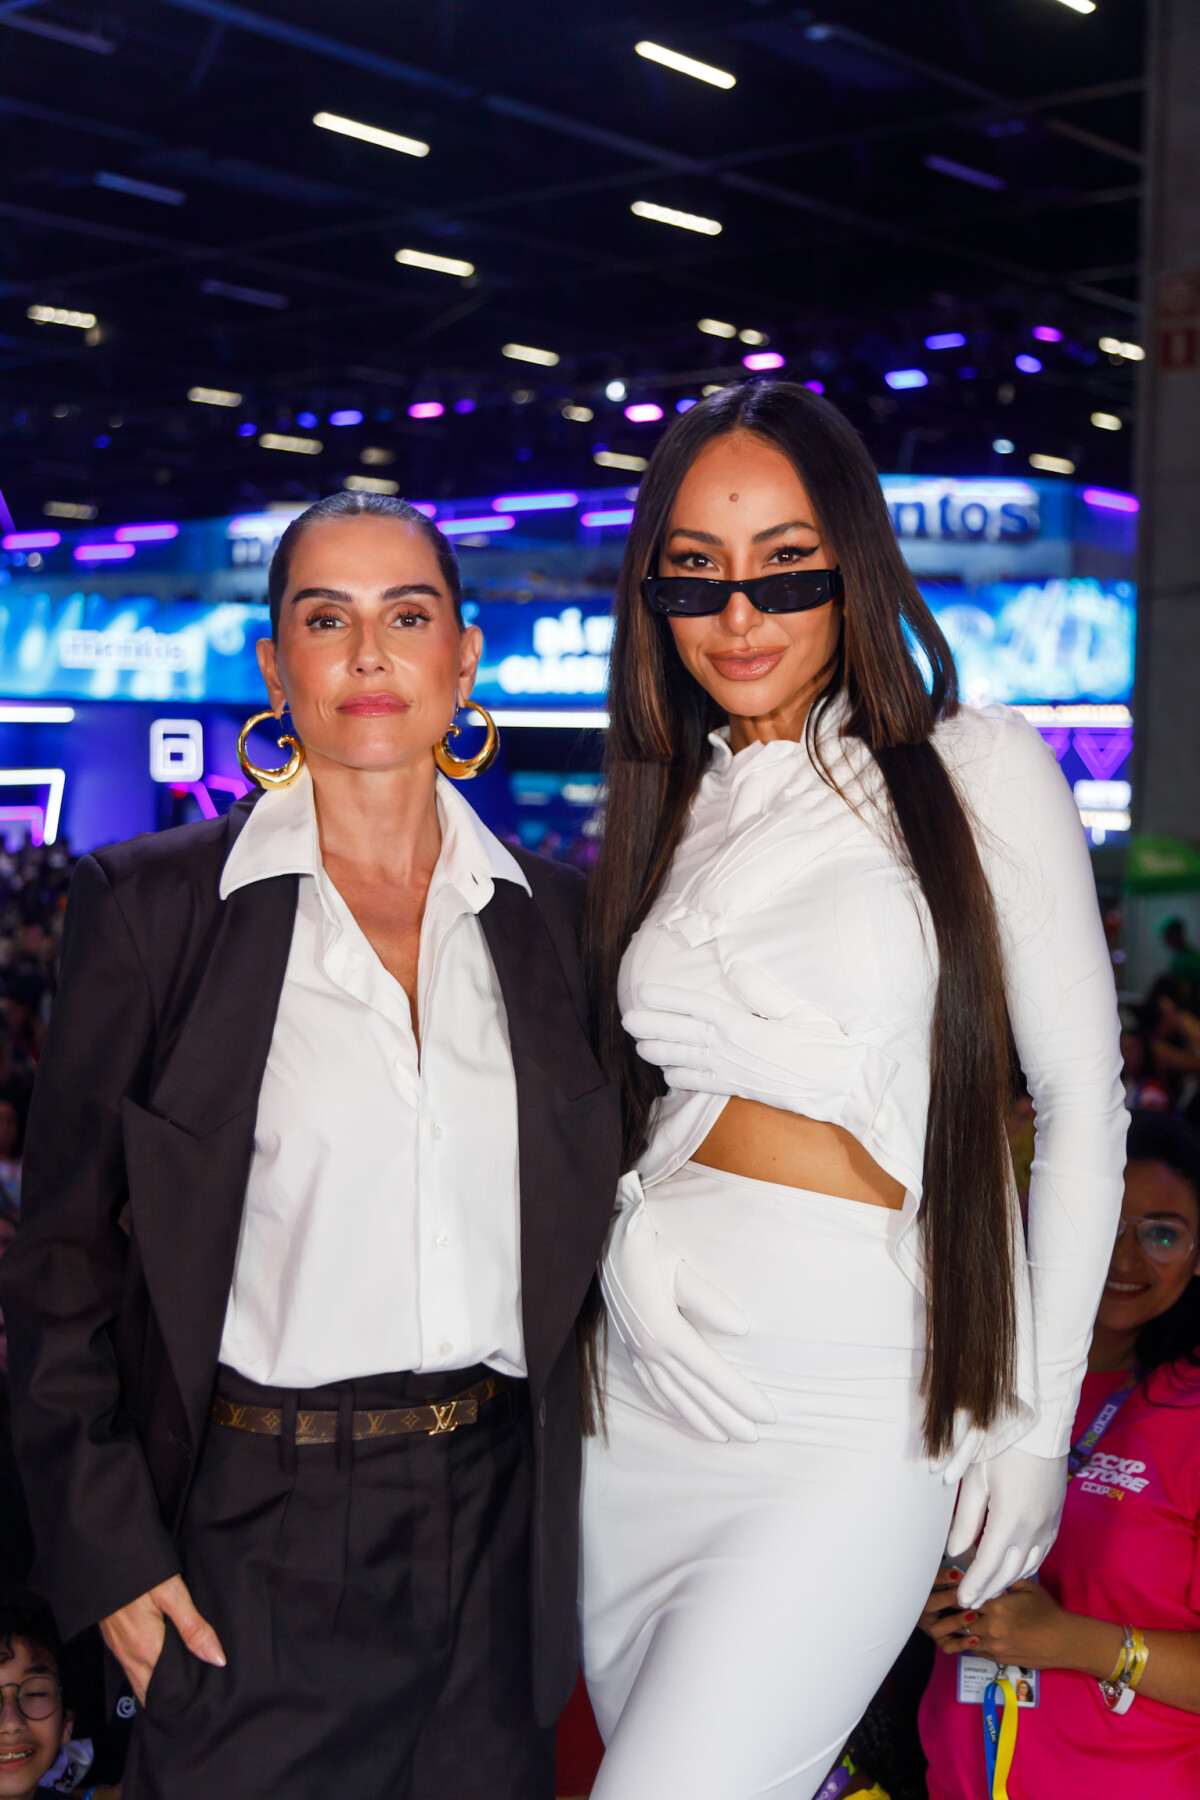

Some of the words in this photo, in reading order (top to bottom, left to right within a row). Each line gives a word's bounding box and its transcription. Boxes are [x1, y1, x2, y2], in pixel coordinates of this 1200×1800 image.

[887, 487, 1037, 543] ntos
[1089, 1452, 1146, 1474] CCXP
[1076, 1466, 1150, 1493] STORE
